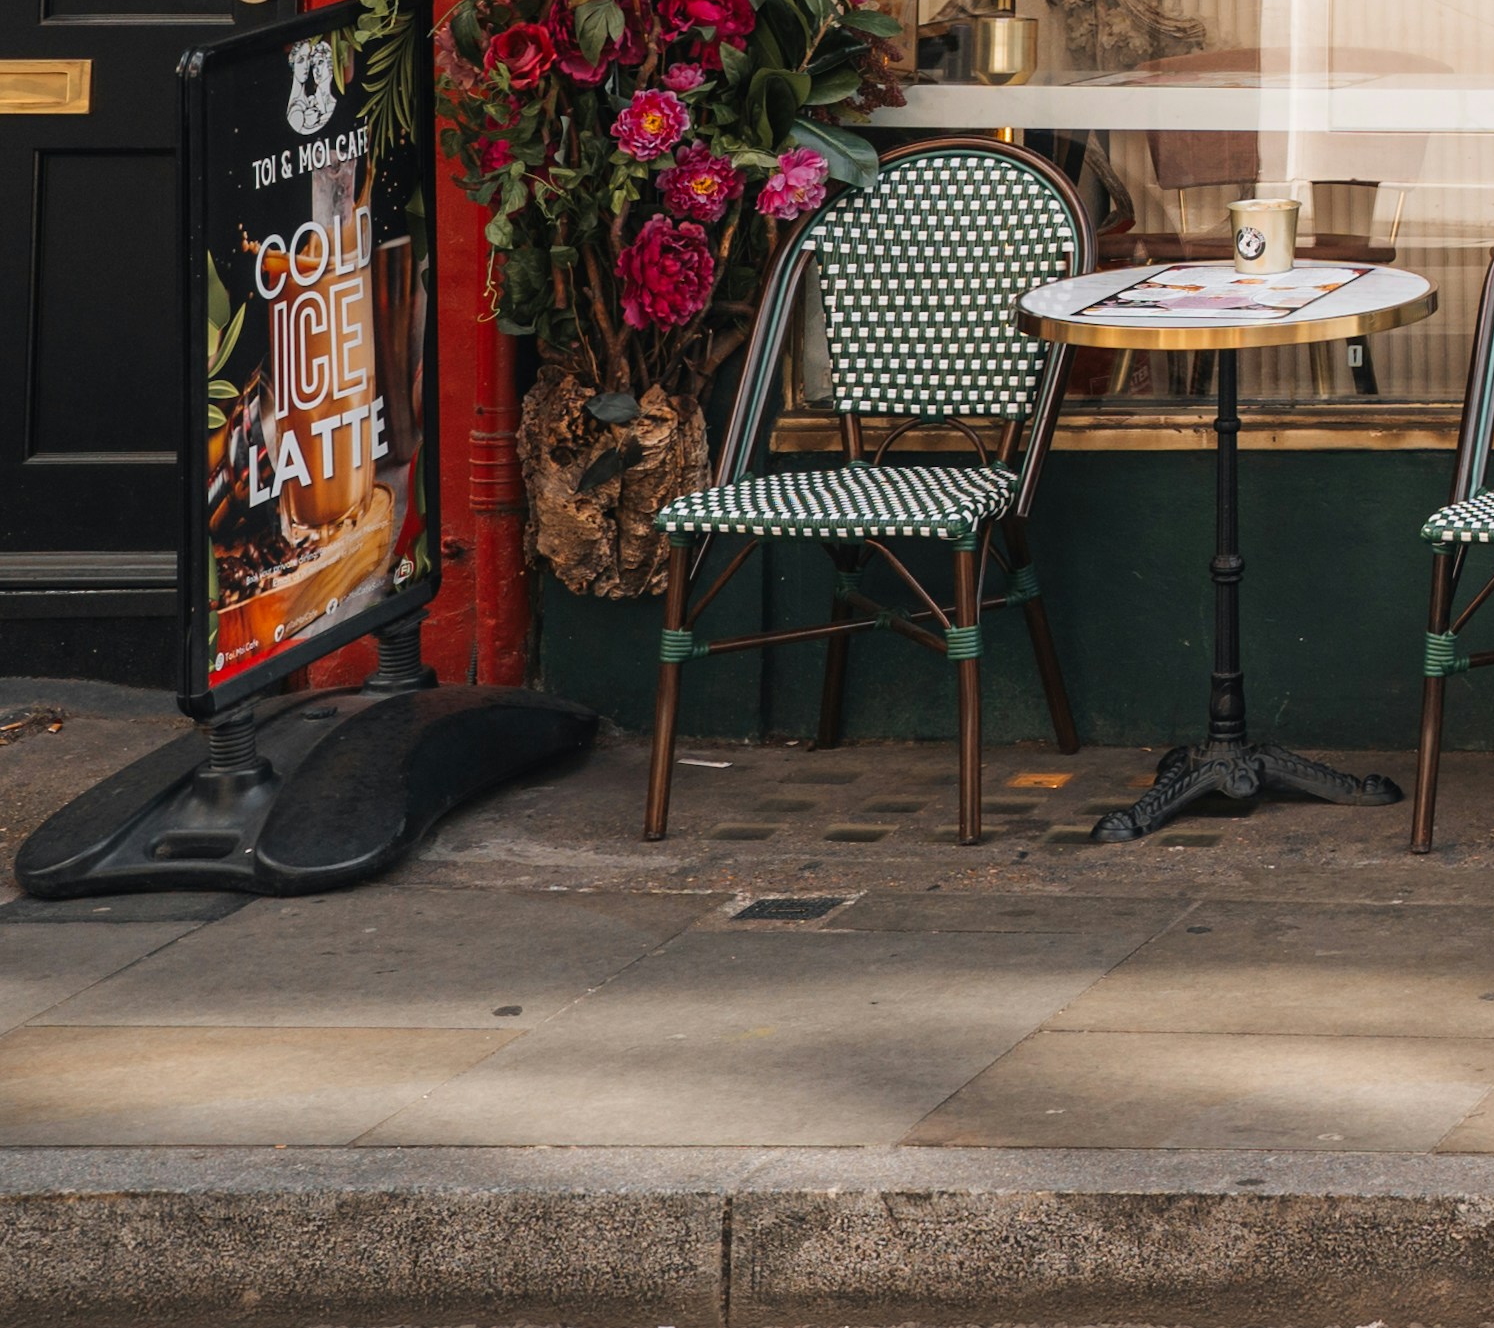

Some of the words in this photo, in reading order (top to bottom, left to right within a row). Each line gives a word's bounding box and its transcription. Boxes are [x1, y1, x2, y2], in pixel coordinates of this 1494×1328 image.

[252, 155, 276, 189] TOI
[281, 150, 294, 180] &
[298, 137, 332, 175] MOI
[335, 115, 369, 163] CAFÉ
[254, 205, 372, 300] COLD
[273, 276, 368, 421] ICE
[249, 395, 389, 509] LATTE
